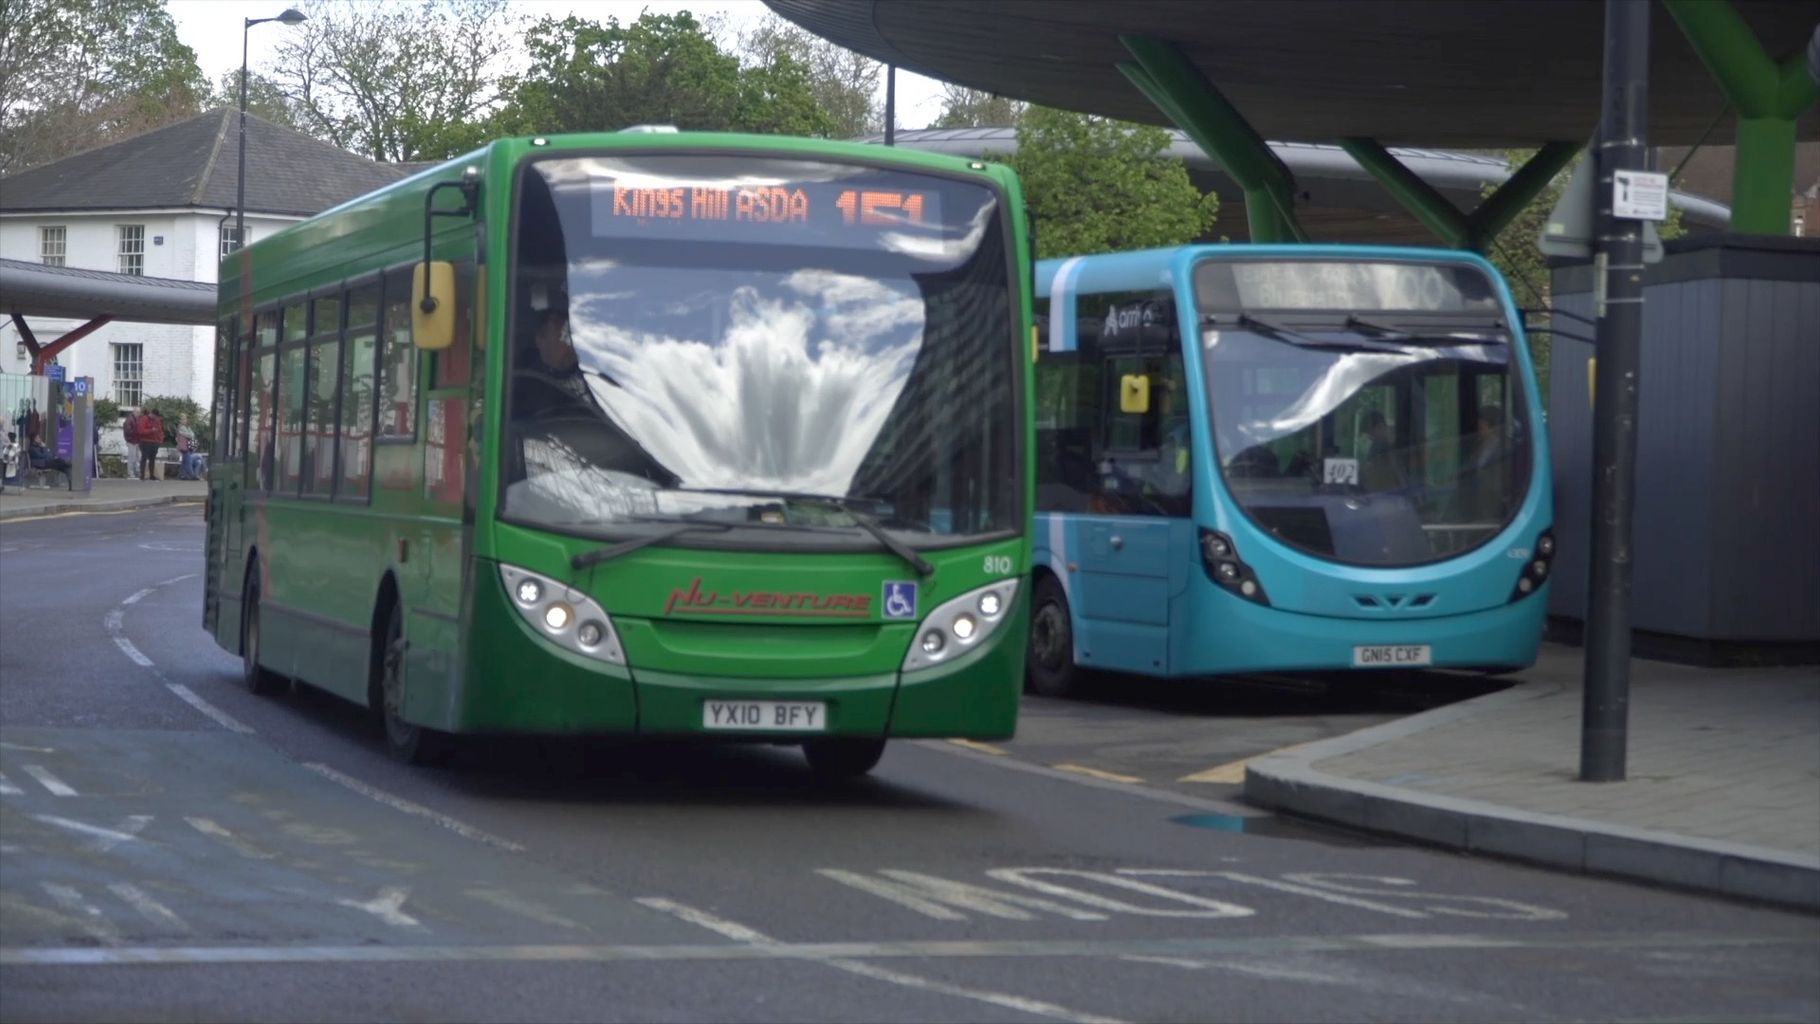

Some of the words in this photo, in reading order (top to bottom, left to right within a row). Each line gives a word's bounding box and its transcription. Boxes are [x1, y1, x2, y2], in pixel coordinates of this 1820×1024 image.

[612, 184, 685, 219] Kings
[690, 186, 730, 221] Hill
[734, 187, 810, 224] ASDA
[835, 190, 924, 225] 151
[74, 381, 86, 392] 10
[983, 556, 1012, 575] 810
[1361, 647, 1392, 664] GN15
[1395, 647, 1420, 663] CXF
[710, 703, 761, 726] YX10
[773, 703, 819, 726] BFY
